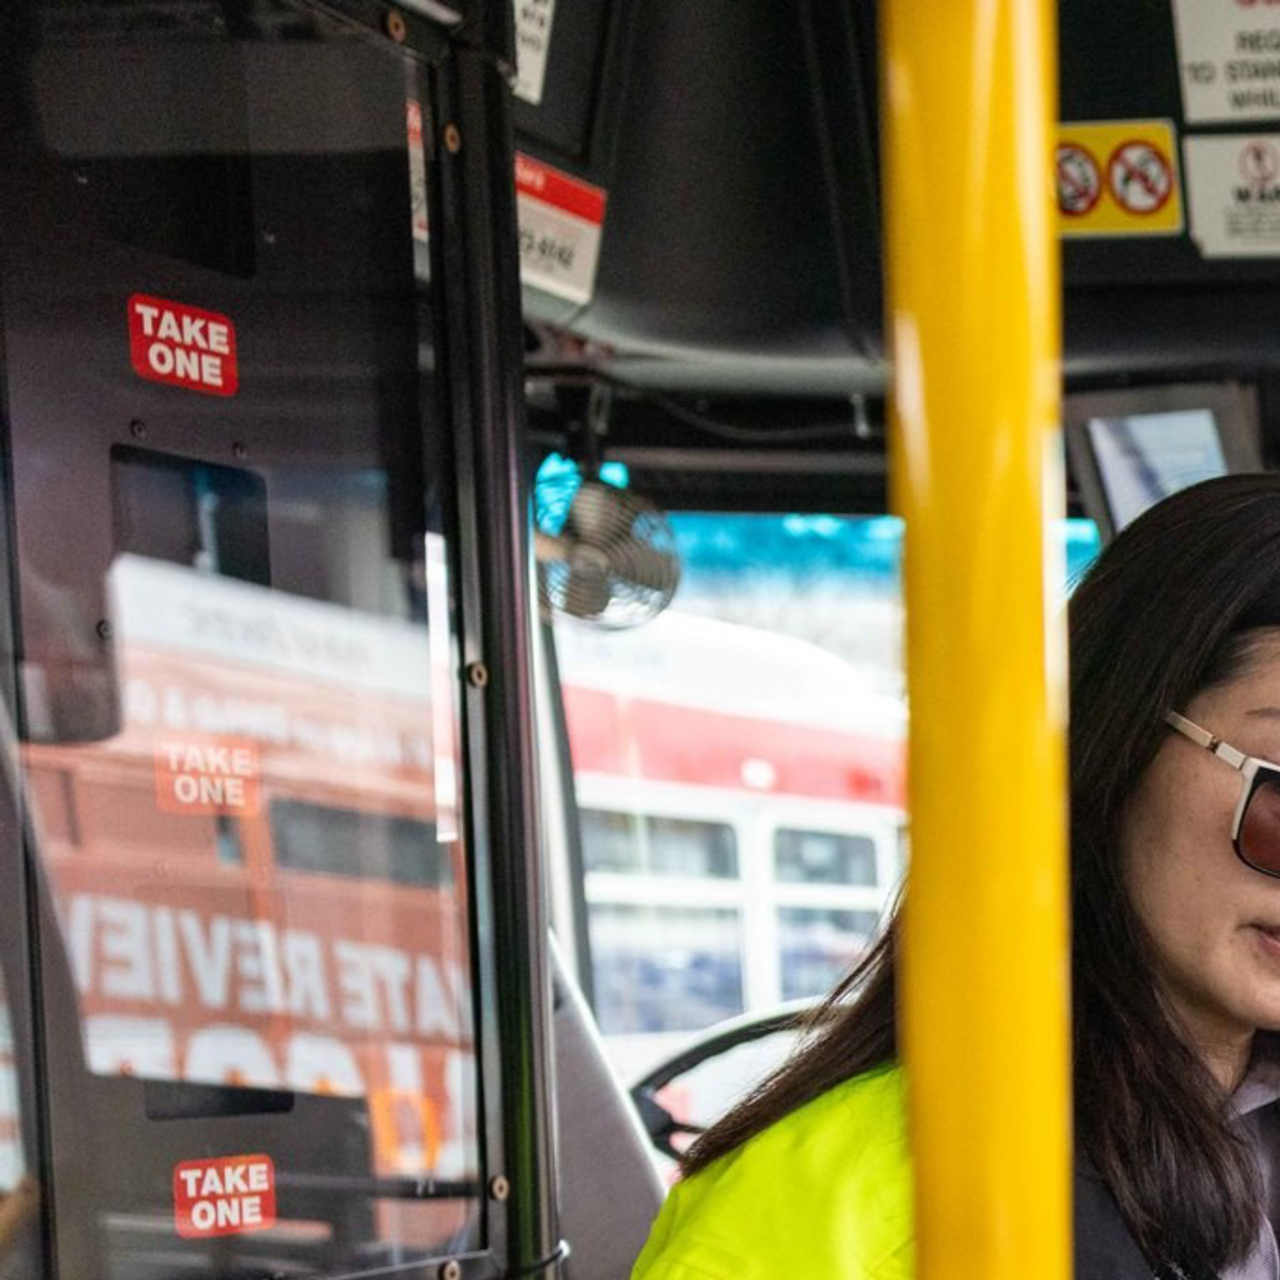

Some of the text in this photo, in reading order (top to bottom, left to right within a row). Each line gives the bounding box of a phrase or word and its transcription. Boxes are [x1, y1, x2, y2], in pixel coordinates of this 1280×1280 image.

[1188, 61, 1215, 84] TO
[135, 303, 230, 356] TAKE
[148, 341, 223, 388] ONE
[161, 743, 252, 776] TAKE
[174, 774, 245, 807] ONE
[180, 1163, 269, 1198] TAKE
[191, 1195, 262, 1230] ONE
